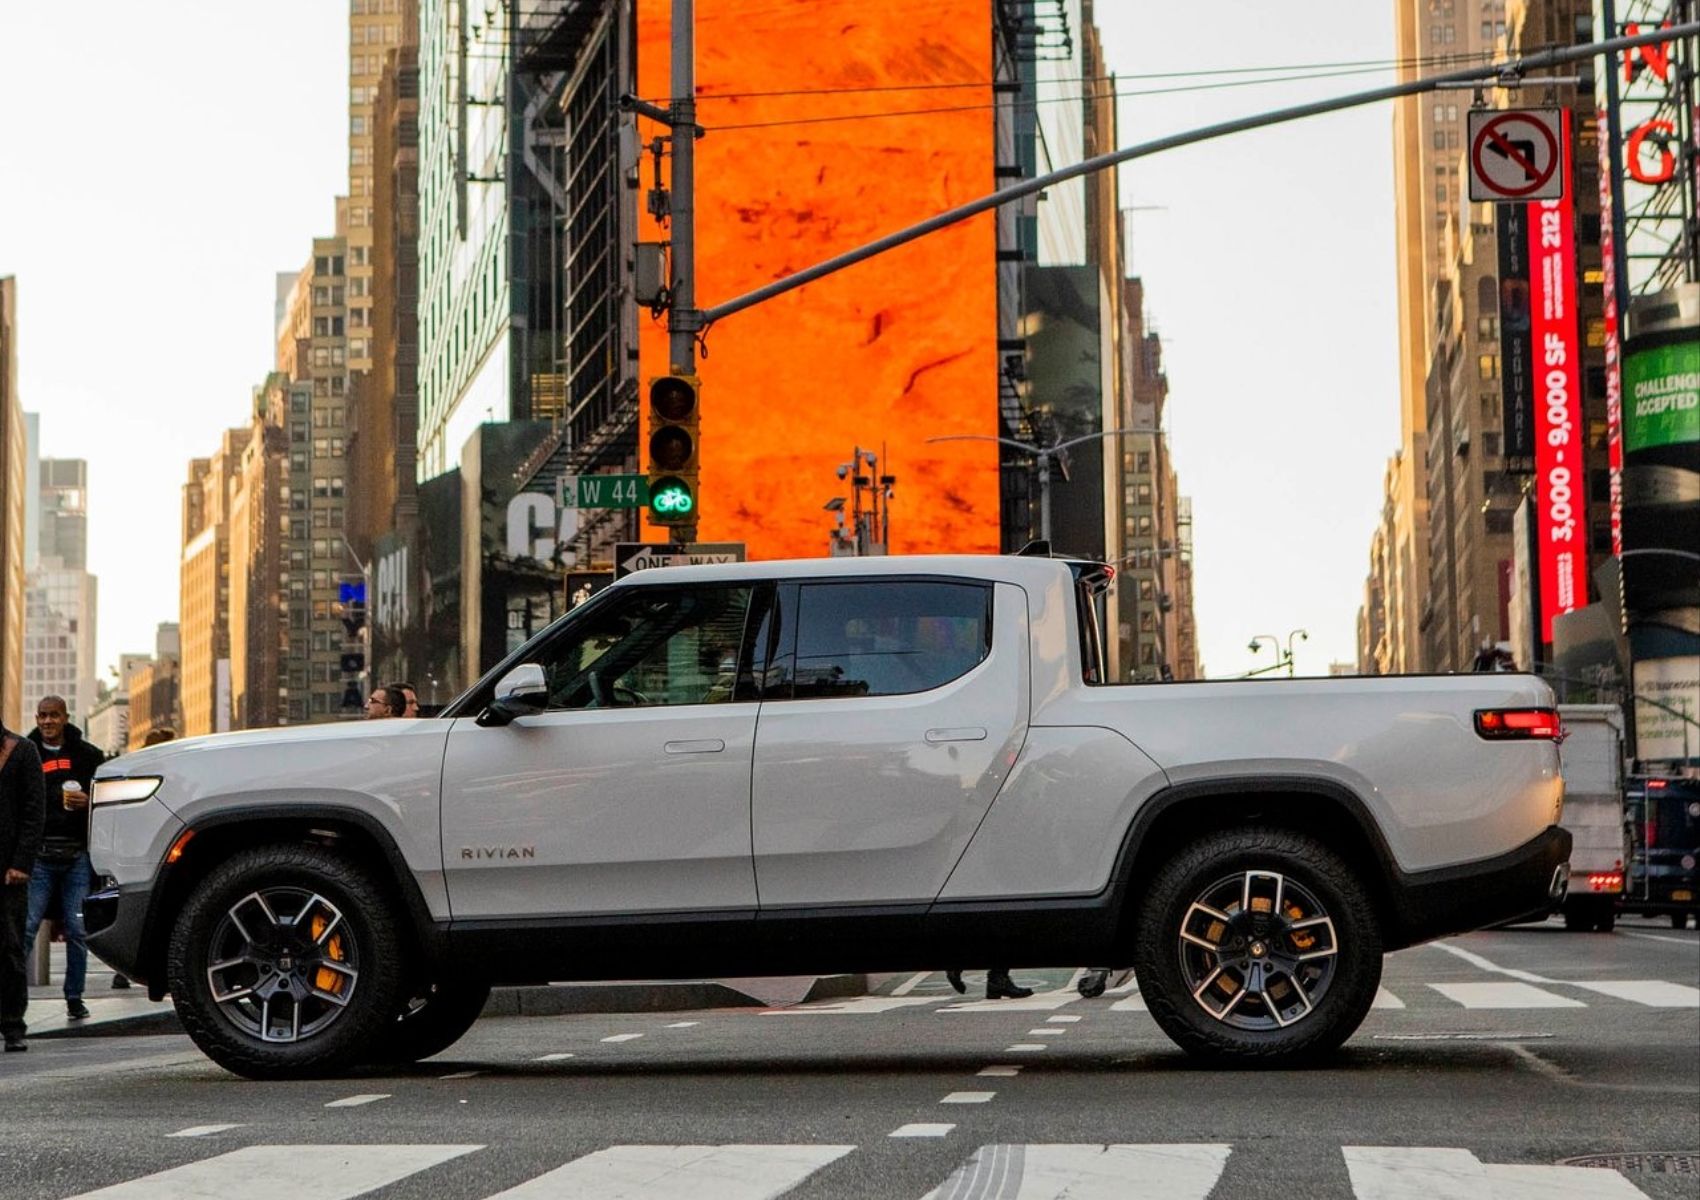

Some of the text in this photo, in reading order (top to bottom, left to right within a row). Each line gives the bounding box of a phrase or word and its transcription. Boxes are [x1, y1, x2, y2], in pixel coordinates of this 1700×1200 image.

[1541, 210, 1561, 248] 212
[1545, 332, 1566, 366] SF
[1546, 370, 1572, 446] 9,000
[1636, 392, 1697, 417] ACCEPTED
[582, 480, 637, 503] W 44
[1550, 466, 1576, 542] 3,000
[635, 556, 671, 570] ONE
[508, 611, 525, 629] OF
[461, 847, 535, 859] RIVIAN
